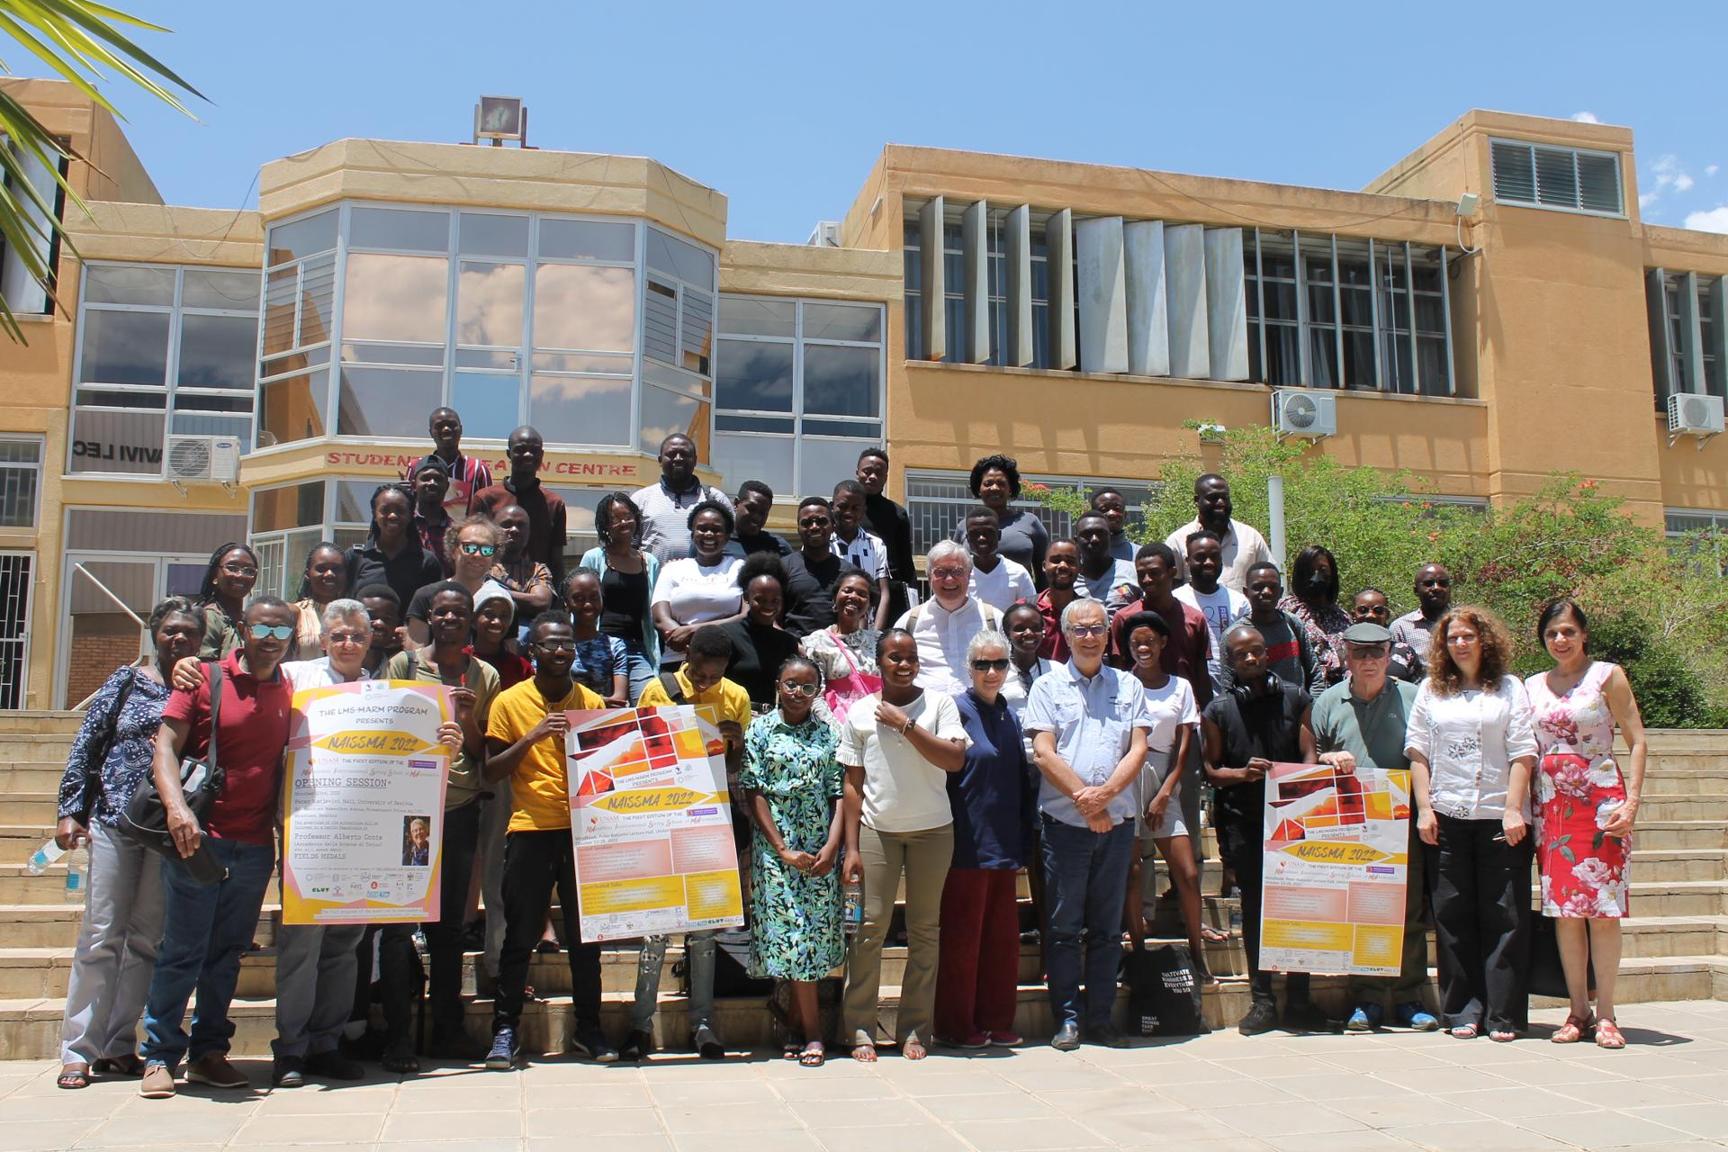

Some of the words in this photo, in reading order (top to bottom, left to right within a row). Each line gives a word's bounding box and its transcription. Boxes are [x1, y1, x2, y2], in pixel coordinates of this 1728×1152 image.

[556, 462, 637, 476] CENTRE
[320, 708, 335, 717] THE
[388, 706, 428, 715] PROGRAM
[328, 735, 388, 750] NAISSMA
[390, 736, 418, 751] 2022
[607, 793, 661, 810] NAISSMA
[665, 791, 695, 806] 2022
[1296, 845, 1346, 859] NAISSMA
[1348, 848, 1377, 861] 2022
